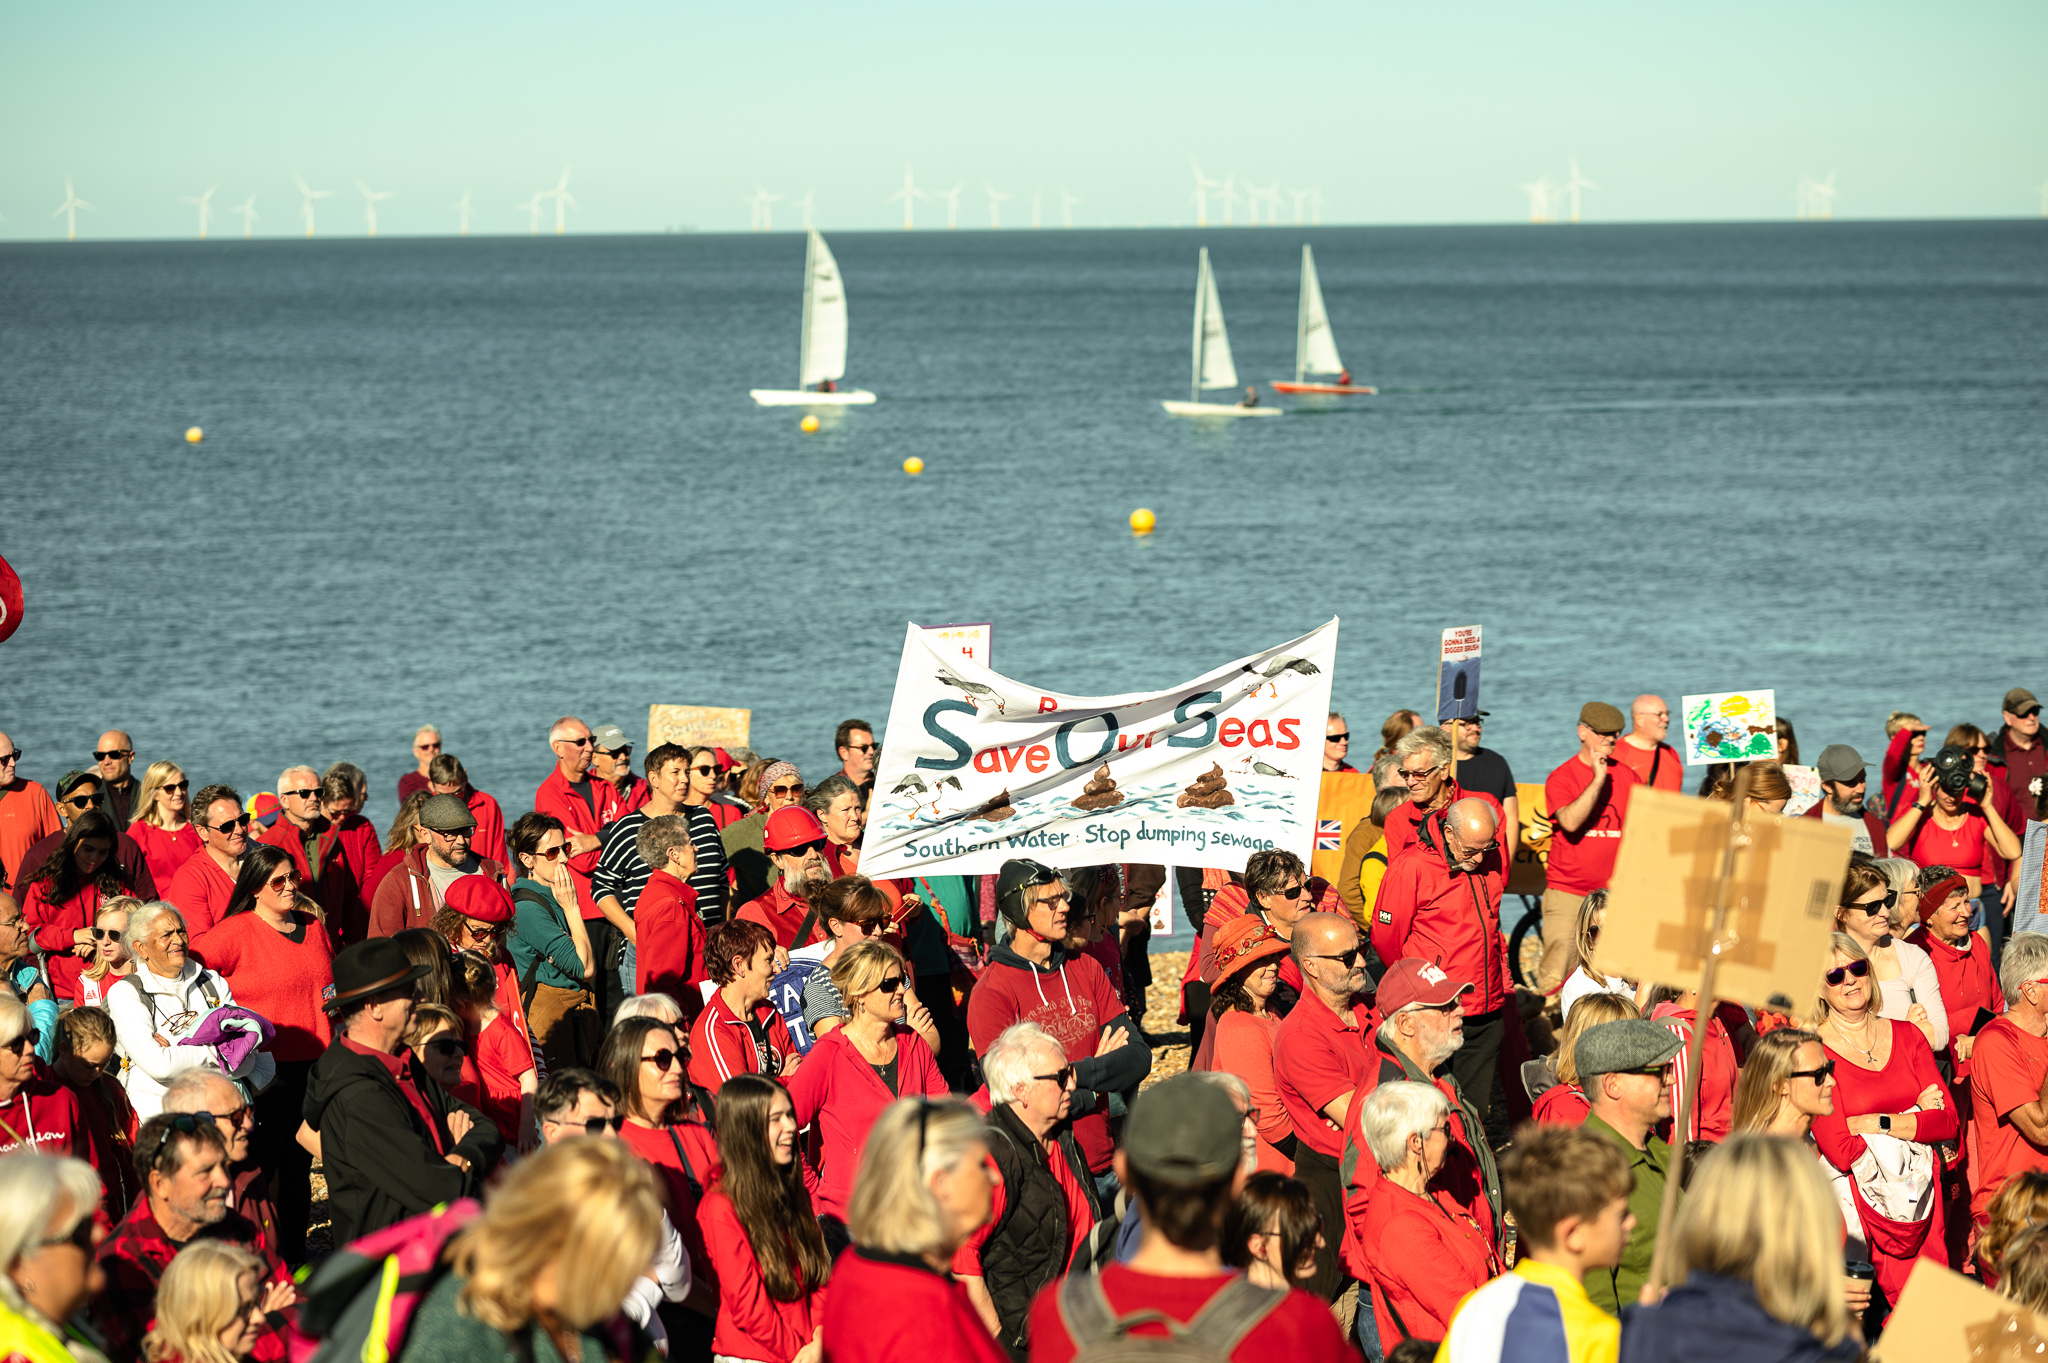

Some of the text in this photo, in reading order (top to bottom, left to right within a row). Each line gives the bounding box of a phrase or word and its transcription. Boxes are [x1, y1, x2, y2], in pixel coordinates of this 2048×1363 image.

[1444, 638, 1463, 646] GONNA
[962, 646, 973, 659] 4
[1444, 645, 1463, 654] BIGGER
[914, 690, 1301, 774] Save Our Seas
[904, 837, 1000, 858] Southern
[1005, 830, 1070, 849] Water
[1085, 822, 1131, 850] Stop
[1136, 820, 1206, 852] dumping
[1210, 830, 1275, 852] sewage
[1515, 849, 1548, 864] cra
